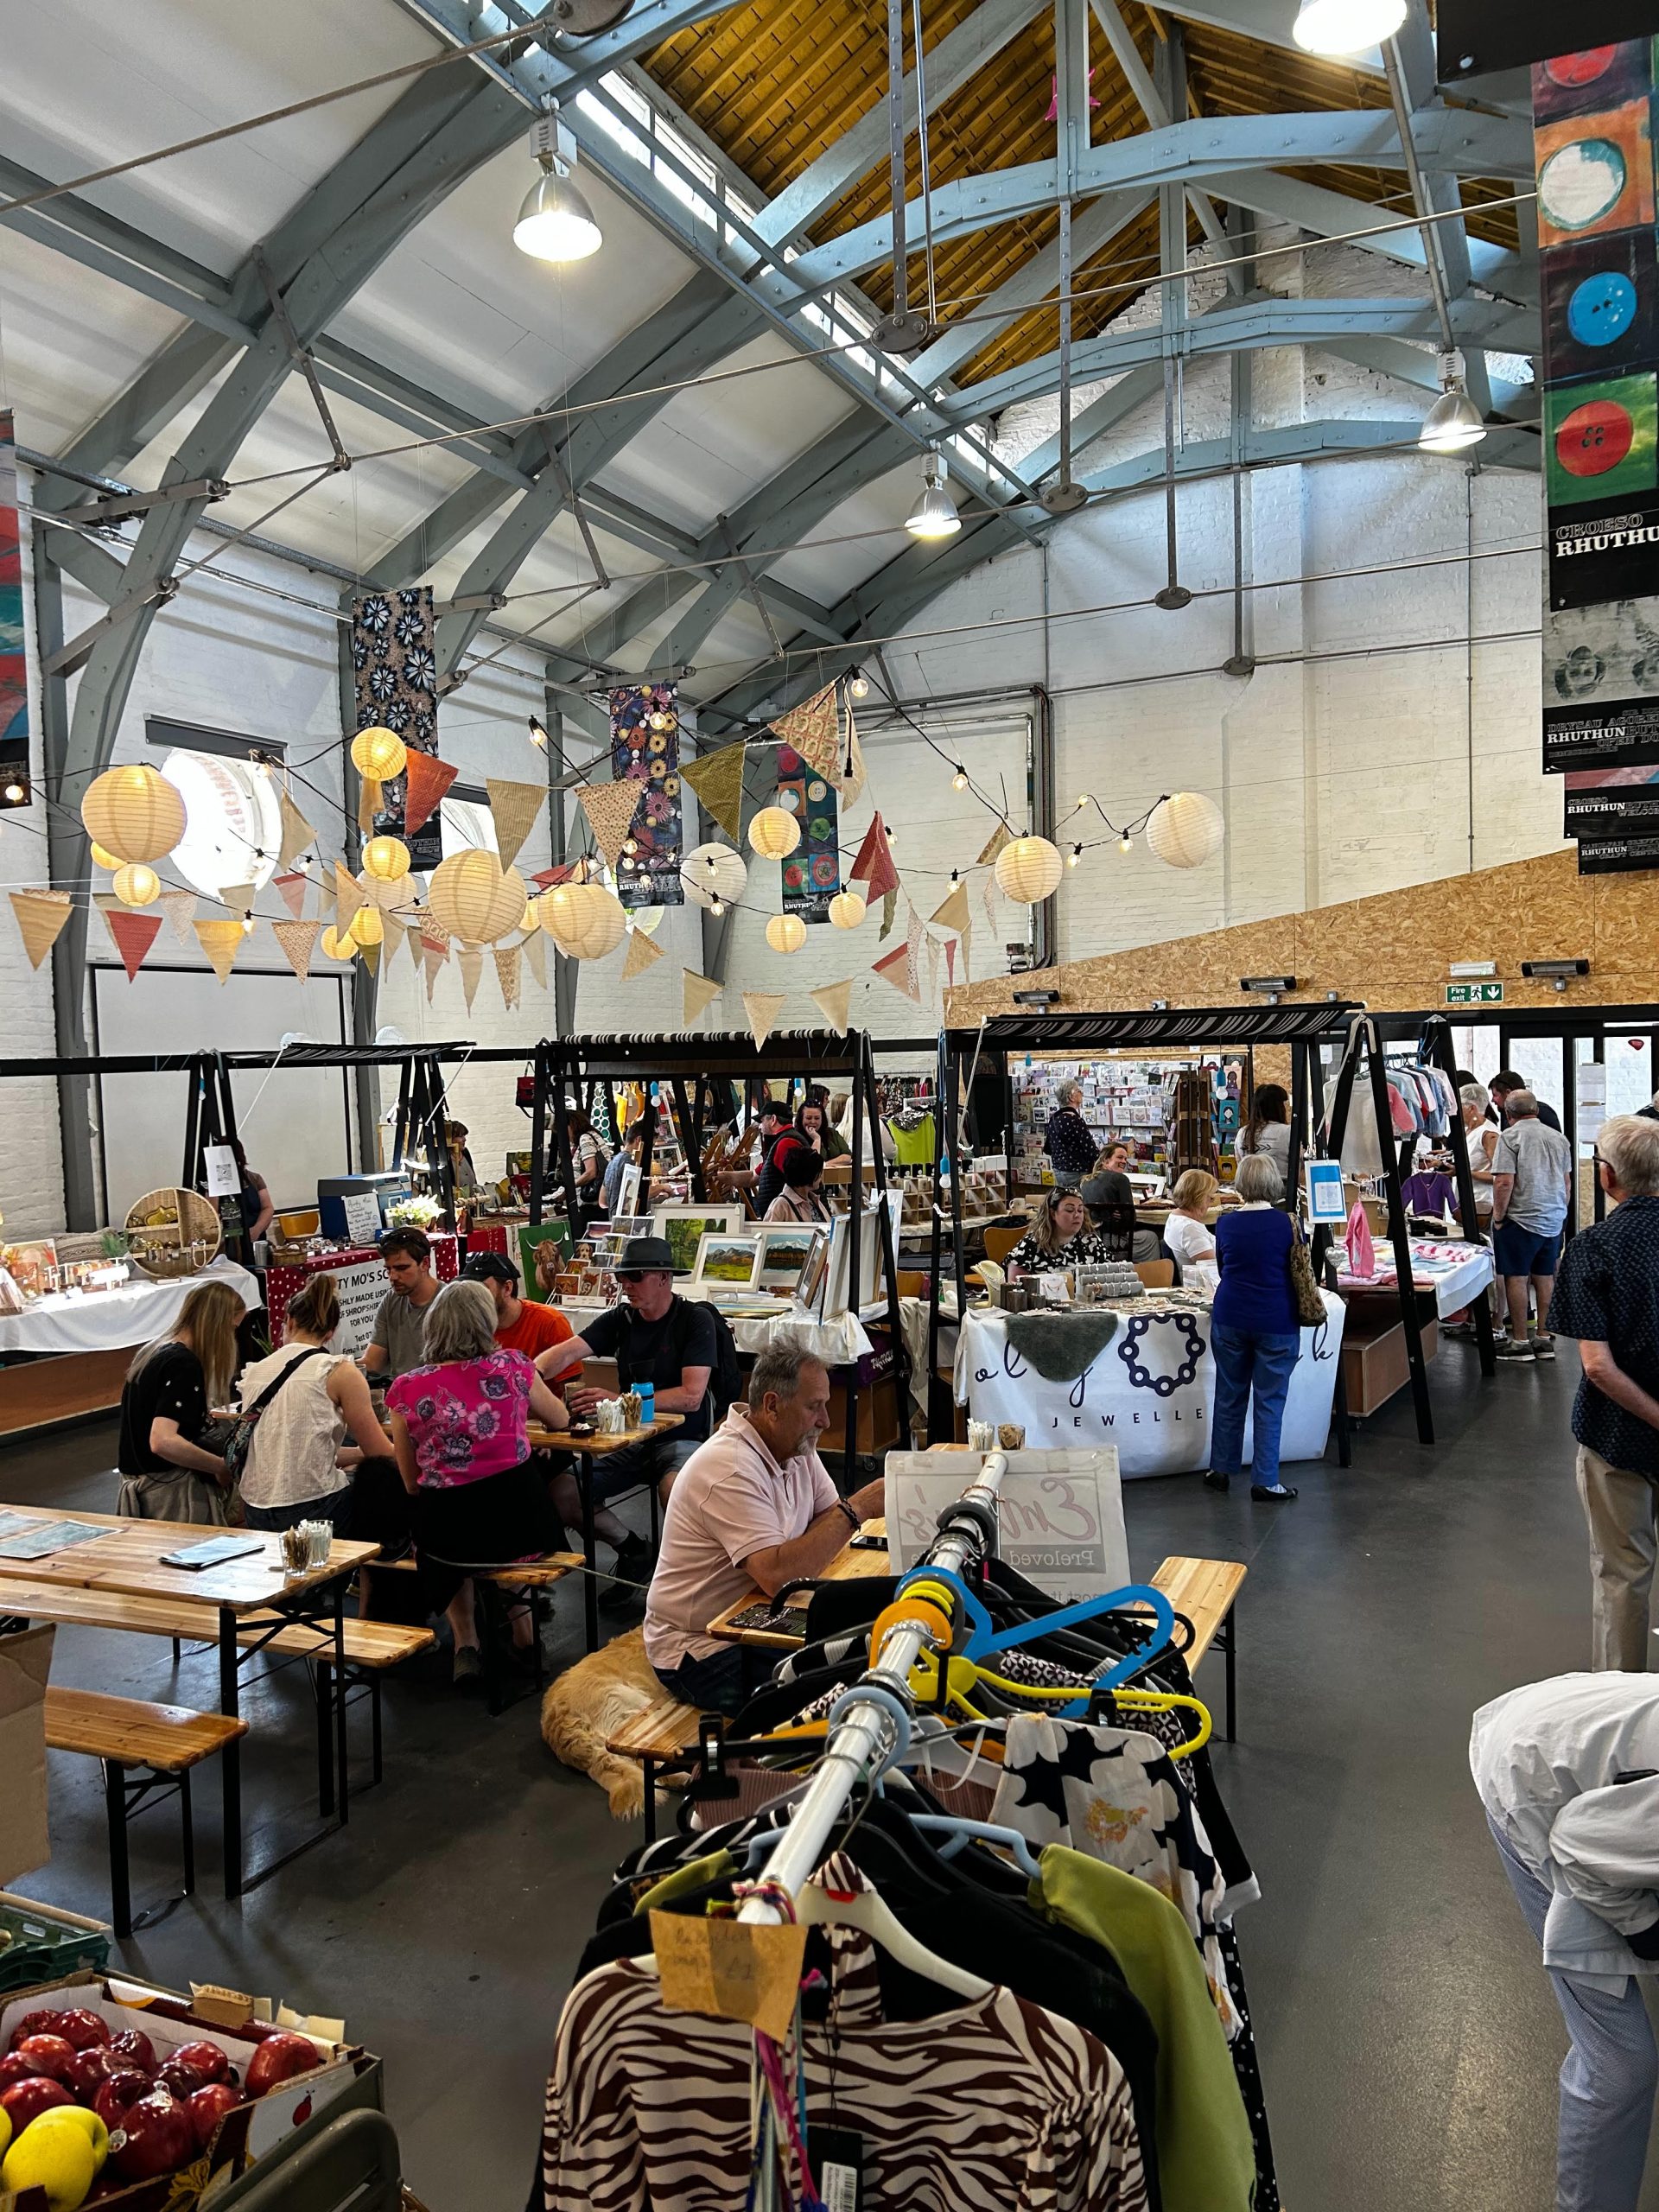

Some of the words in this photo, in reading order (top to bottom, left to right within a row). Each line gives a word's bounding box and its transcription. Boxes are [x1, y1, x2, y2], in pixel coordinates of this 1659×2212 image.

[1555, 513, 1643, 540] CROESO
[1547, 727, 1626, 744] RHUTHUN
[1567, 802, 1626, 814] RHUTHUN
[1581, 846, 1628, 856] RHUTHUN
[351, 1271, 375, 1287] MO'S
[355, 1291, 374, 1303] MADE
[346, 1301, 380, 1316] SHROPSHIR
[350, 1318, 361, 1327] FOR
[361, 1314, 373, 1325] YOU
[1052, 1408, 1202, 1429] JEWELLE
